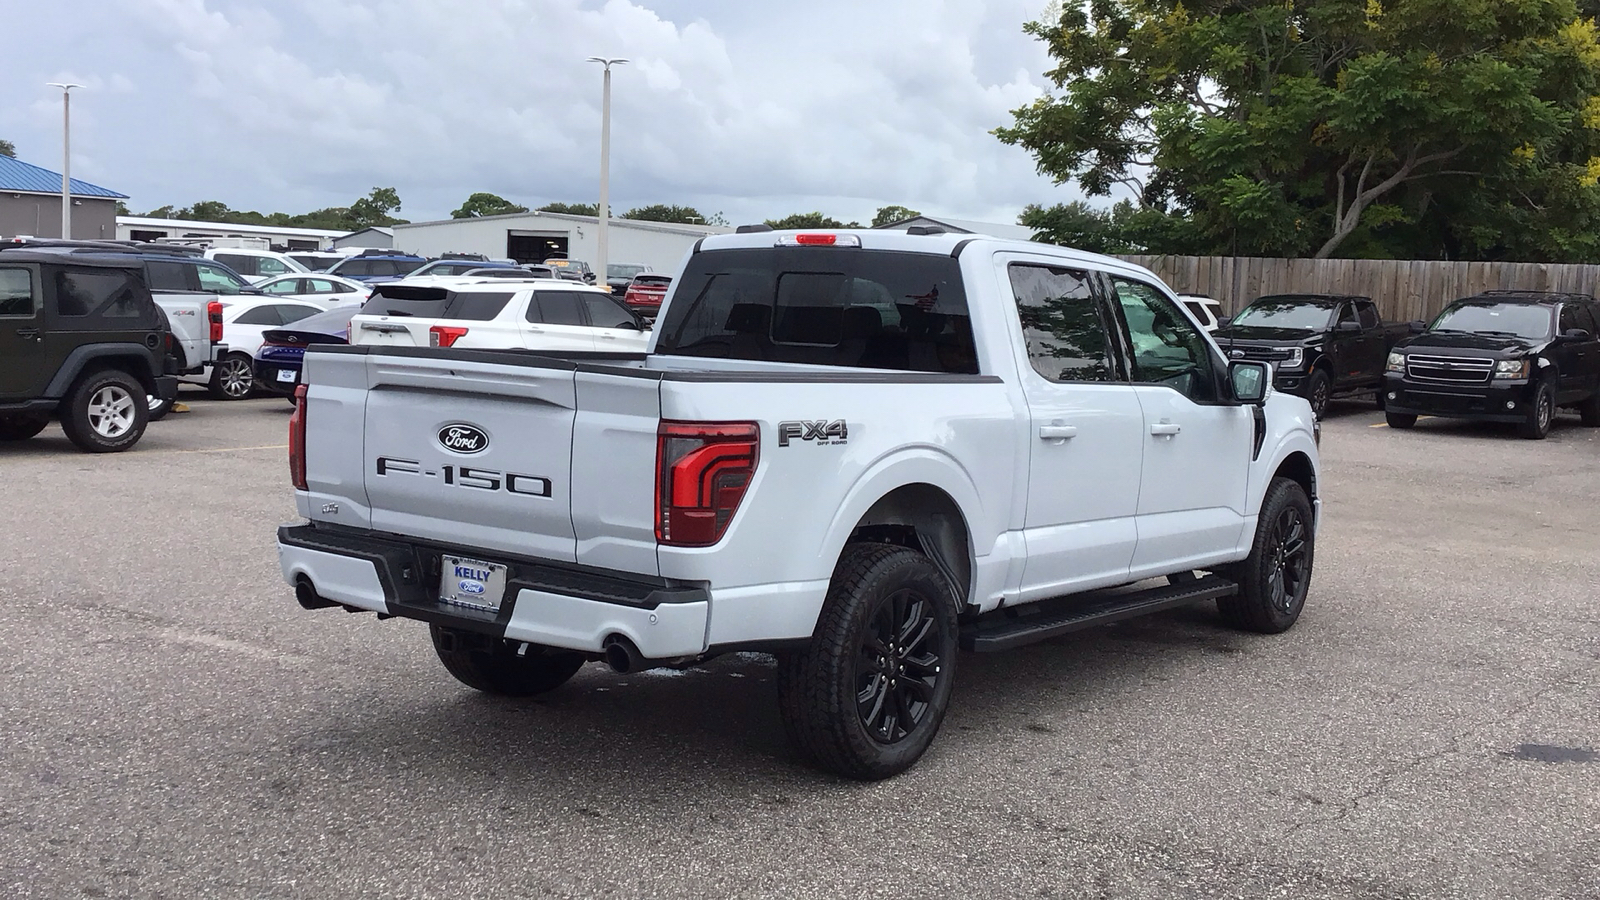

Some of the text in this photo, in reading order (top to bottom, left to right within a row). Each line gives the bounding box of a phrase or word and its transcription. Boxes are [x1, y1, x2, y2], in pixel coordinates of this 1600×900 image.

[445, 427, 478, 449] Ford
[778, 419, 848, 447] FX4
[376, 457, 552, 498] F-150
[454, 566, 490, 582] KELLY
